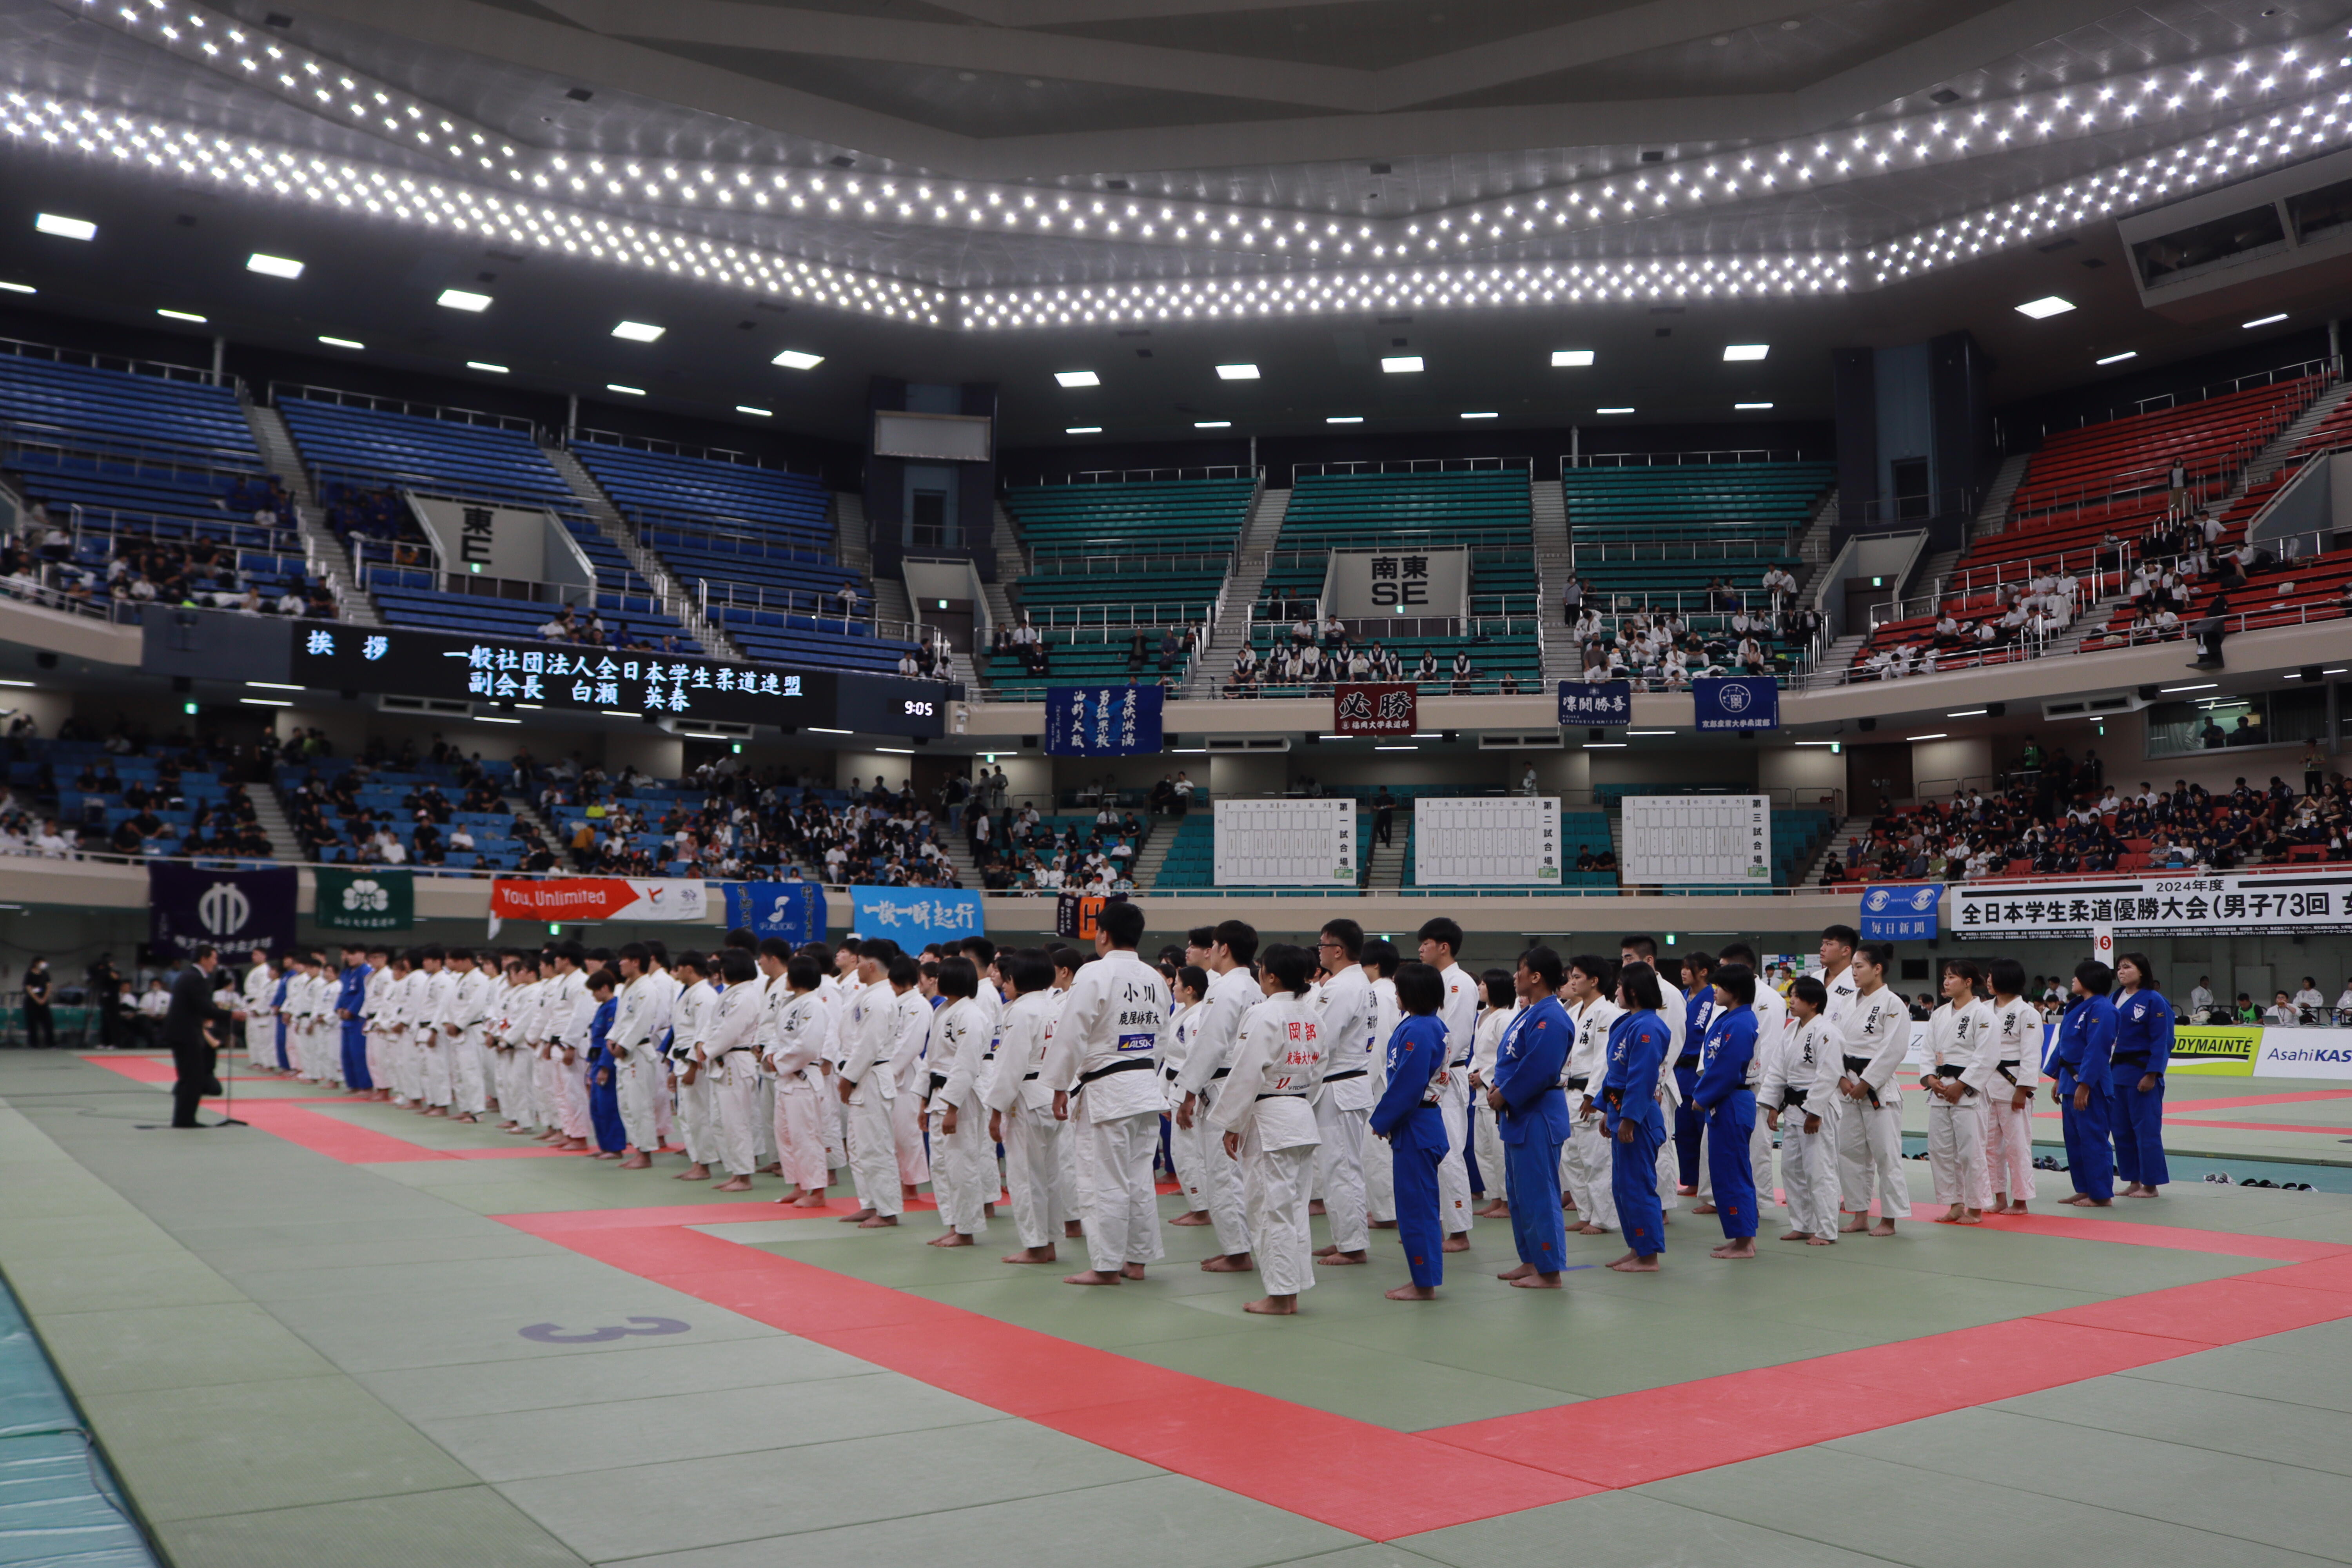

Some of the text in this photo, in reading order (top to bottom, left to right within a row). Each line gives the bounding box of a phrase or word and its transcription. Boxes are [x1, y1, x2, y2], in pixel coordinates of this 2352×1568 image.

[463, 508, 493, 535] 東
[461, 535, 492, 564] E
[1371, 556, 1428, 580] 南東
[1372, 581, 1428, 605] SE
[443, 644, 802, 696] 一般社団法人全日本学生柔道連盟
[468, 671, 691, 711] 副会長 白瀬 英春
[905, 701, 933, 716] 9:05
[1339, 691, 1412, 719] 必勝
[1352, 720, 1410, 730] 福岡大学柔道部
[1702, 719, 1770, 728] 京都産業大学柔道部
[1339, 803, 1348, 866] 第一試合場
[1543, 801, 1553, 865] 第二試合場
[1753, 799, 1762, 864] 第三試合場
[501, 887, 606, 908] You, Unlimited
[2156, 879, 2225, 893] 2024年度
[1871, 921, 1924, 935] 毎日新聞
[1124, 983, 1155, 1004] 小川
[1118, 1011, 1160, 1025] 鹿屋体育大
[1864, 1006, 1880, 1034] 日経大
[1957, 1016, 1970, 1039] 福岡大
[2004, 1013, 2016, 1036] 福岡大
[1129, 1039, 1153, 1048] ALSOK
[1289, 1022, 1316, 1042] 岡部
[1803, 1033, 1813, 1063] 日経大
[2171, 1037, 2253, 1053] DYMAINTÉ
[1285, 1051, 1319, 1065] 東海大九州
